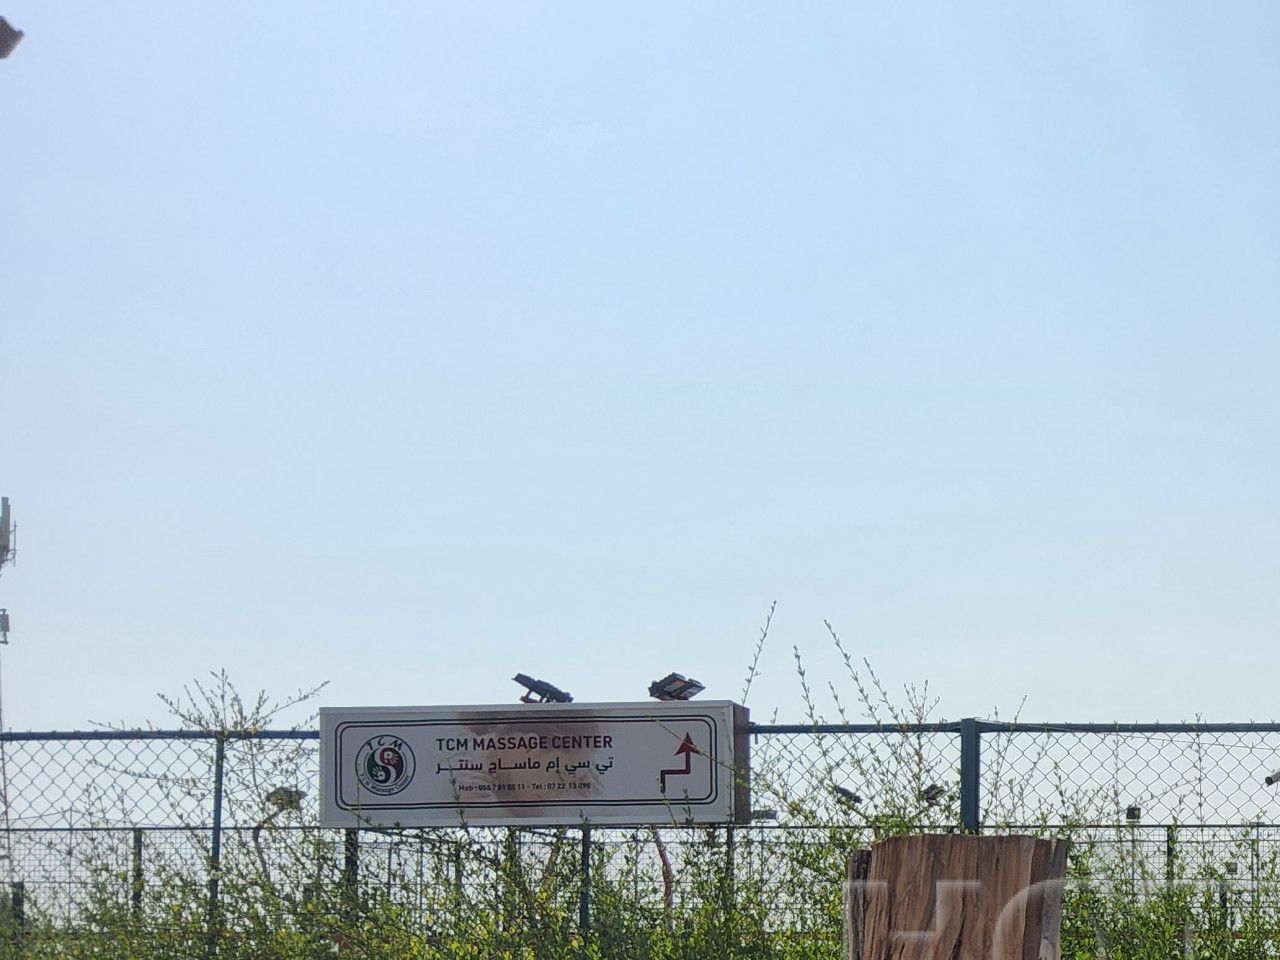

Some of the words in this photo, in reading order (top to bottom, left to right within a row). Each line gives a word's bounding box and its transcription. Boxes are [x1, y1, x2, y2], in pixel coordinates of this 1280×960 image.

[367, 737, 403, 750] TCM
[436, 738, 468, 751] TCM
[473, 736, 548, 750] MASSAGE
[552, 735, 613, 749] CENTER
[565, 760, 590, 775] سي
[595, 757, 614, 775] تي
